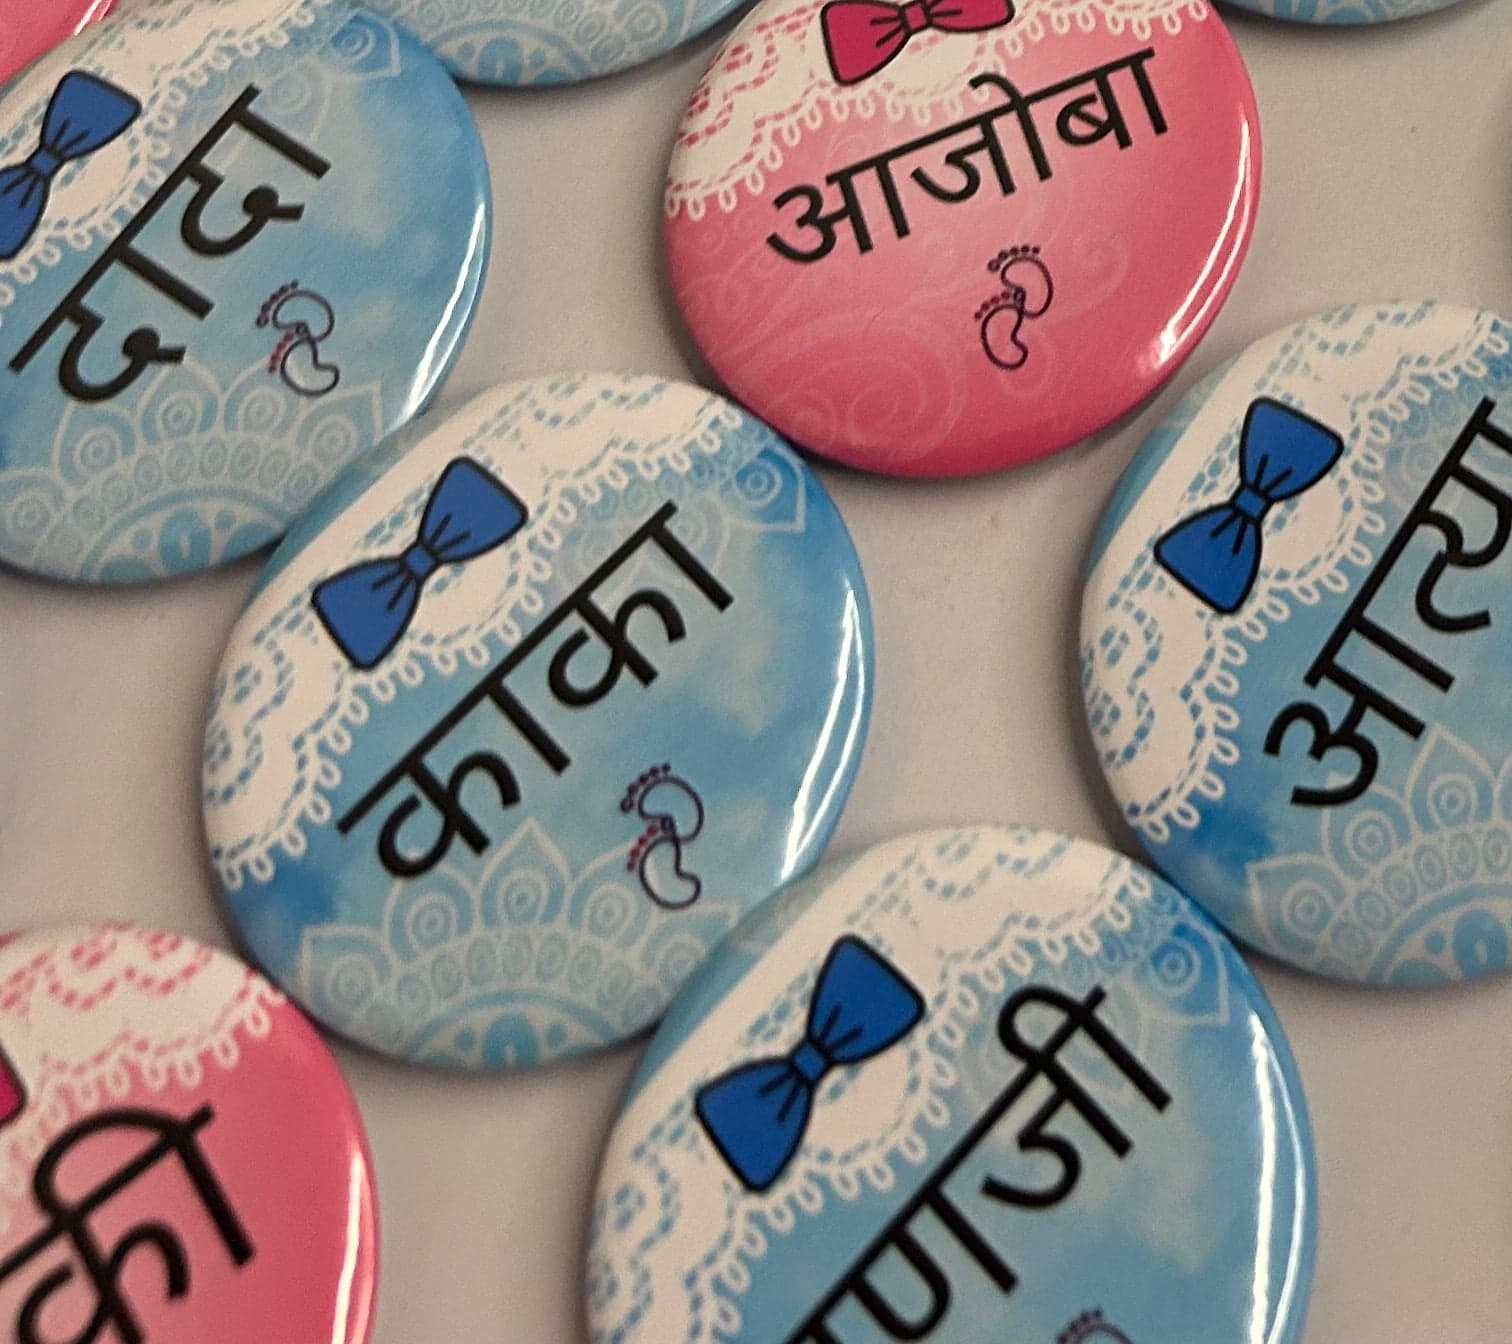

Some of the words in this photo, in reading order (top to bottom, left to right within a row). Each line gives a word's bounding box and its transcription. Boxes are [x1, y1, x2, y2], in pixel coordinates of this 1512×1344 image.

[8, 85, 332, 404] दादा
[765, 48, 1169, 265] आजोबा
[336, 502, 735, 879] काका
[0, 1100, 256, 1344] की
[785, 984, 1172, 1344] णजी
